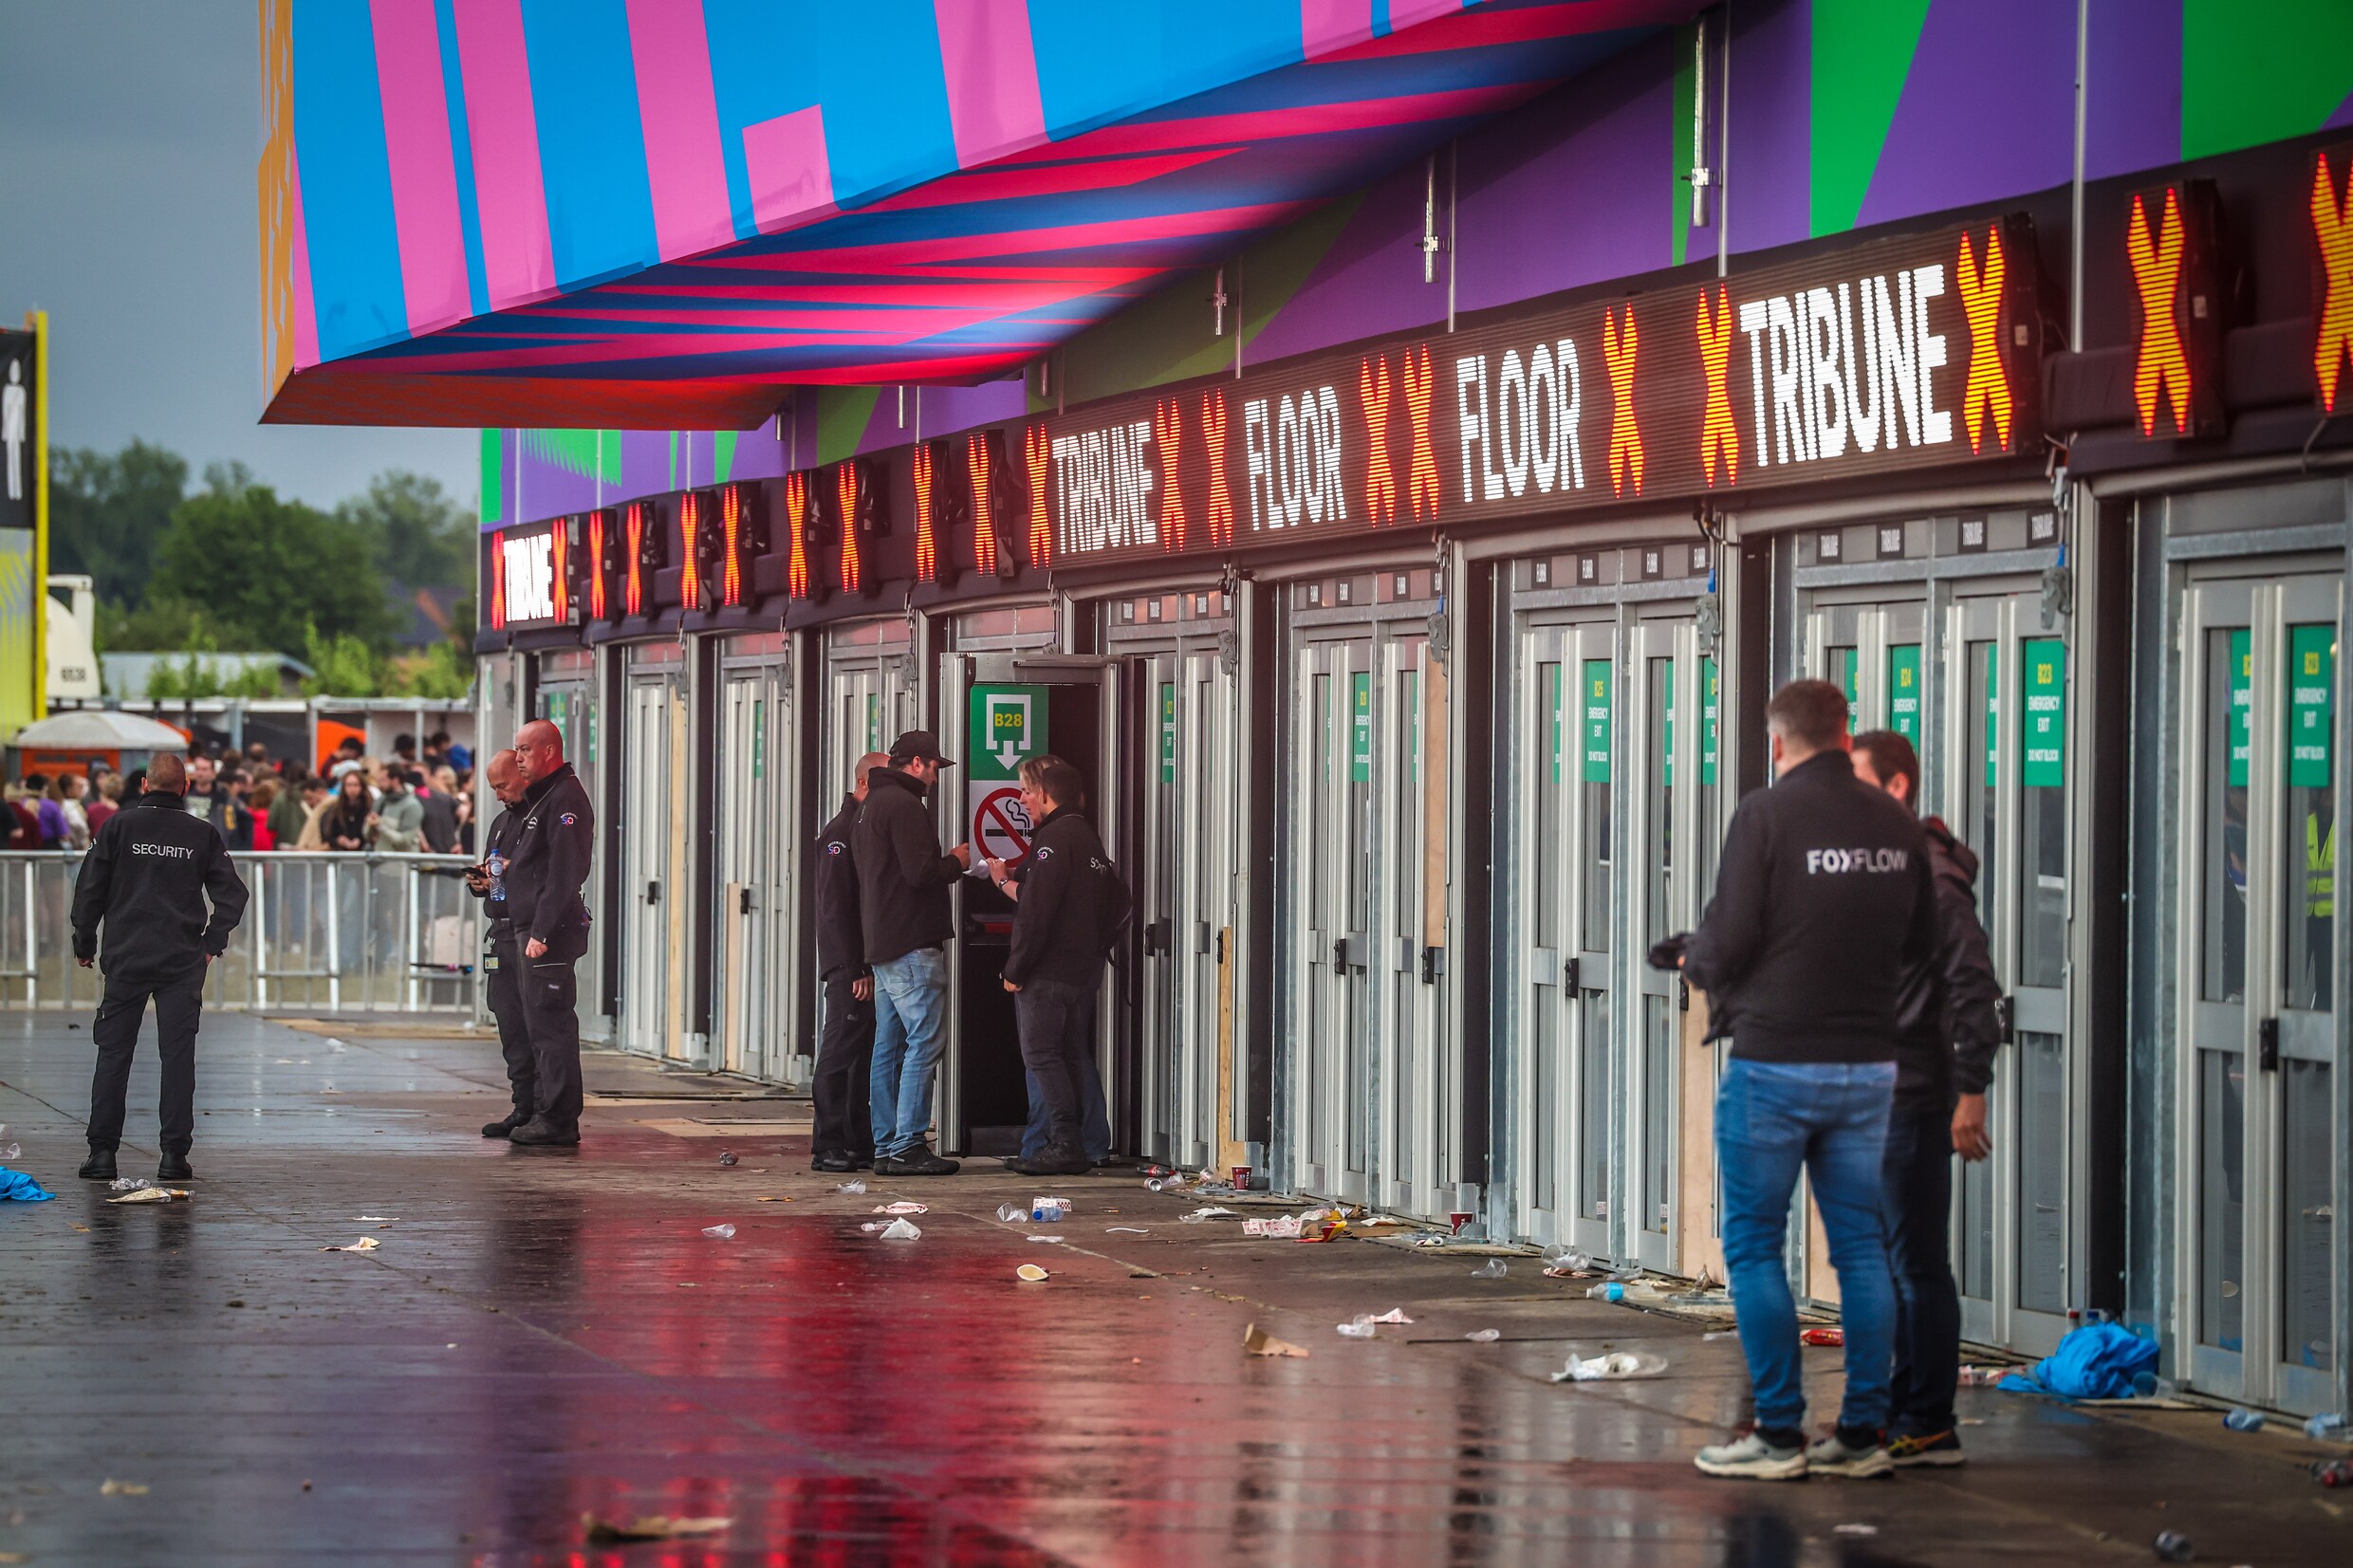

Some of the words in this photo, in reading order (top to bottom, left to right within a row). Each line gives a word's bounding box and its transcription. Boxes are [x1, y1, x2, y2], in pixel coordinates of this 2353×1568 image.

[1739, 264, 1952, 467] TRIBUNE
[1456, 339, 1584, 503] FLOOR
[1244, 386, 1347, 530] FLOOR
[1052, 421, 1157, 554] TRIBUNE
[1894, 699, 1917, 712] EMERGENCY
[2029, 696, 2060, 710] EMERGENCY
[994, 713, 1022, 727] B28
[1588, 707, 1608, 719] EMERGENCY
[1900, 719, 1910, 732] EXIT
[2038, 717, 2049, 732] EXIT
[1599, 751, 1607, 761] BLOCK
[2034, 749, 2043, 761] NOT
[132, 843, 194, 859] SECURITY
[1806, 848, 1908, 874] FOXFLOW
